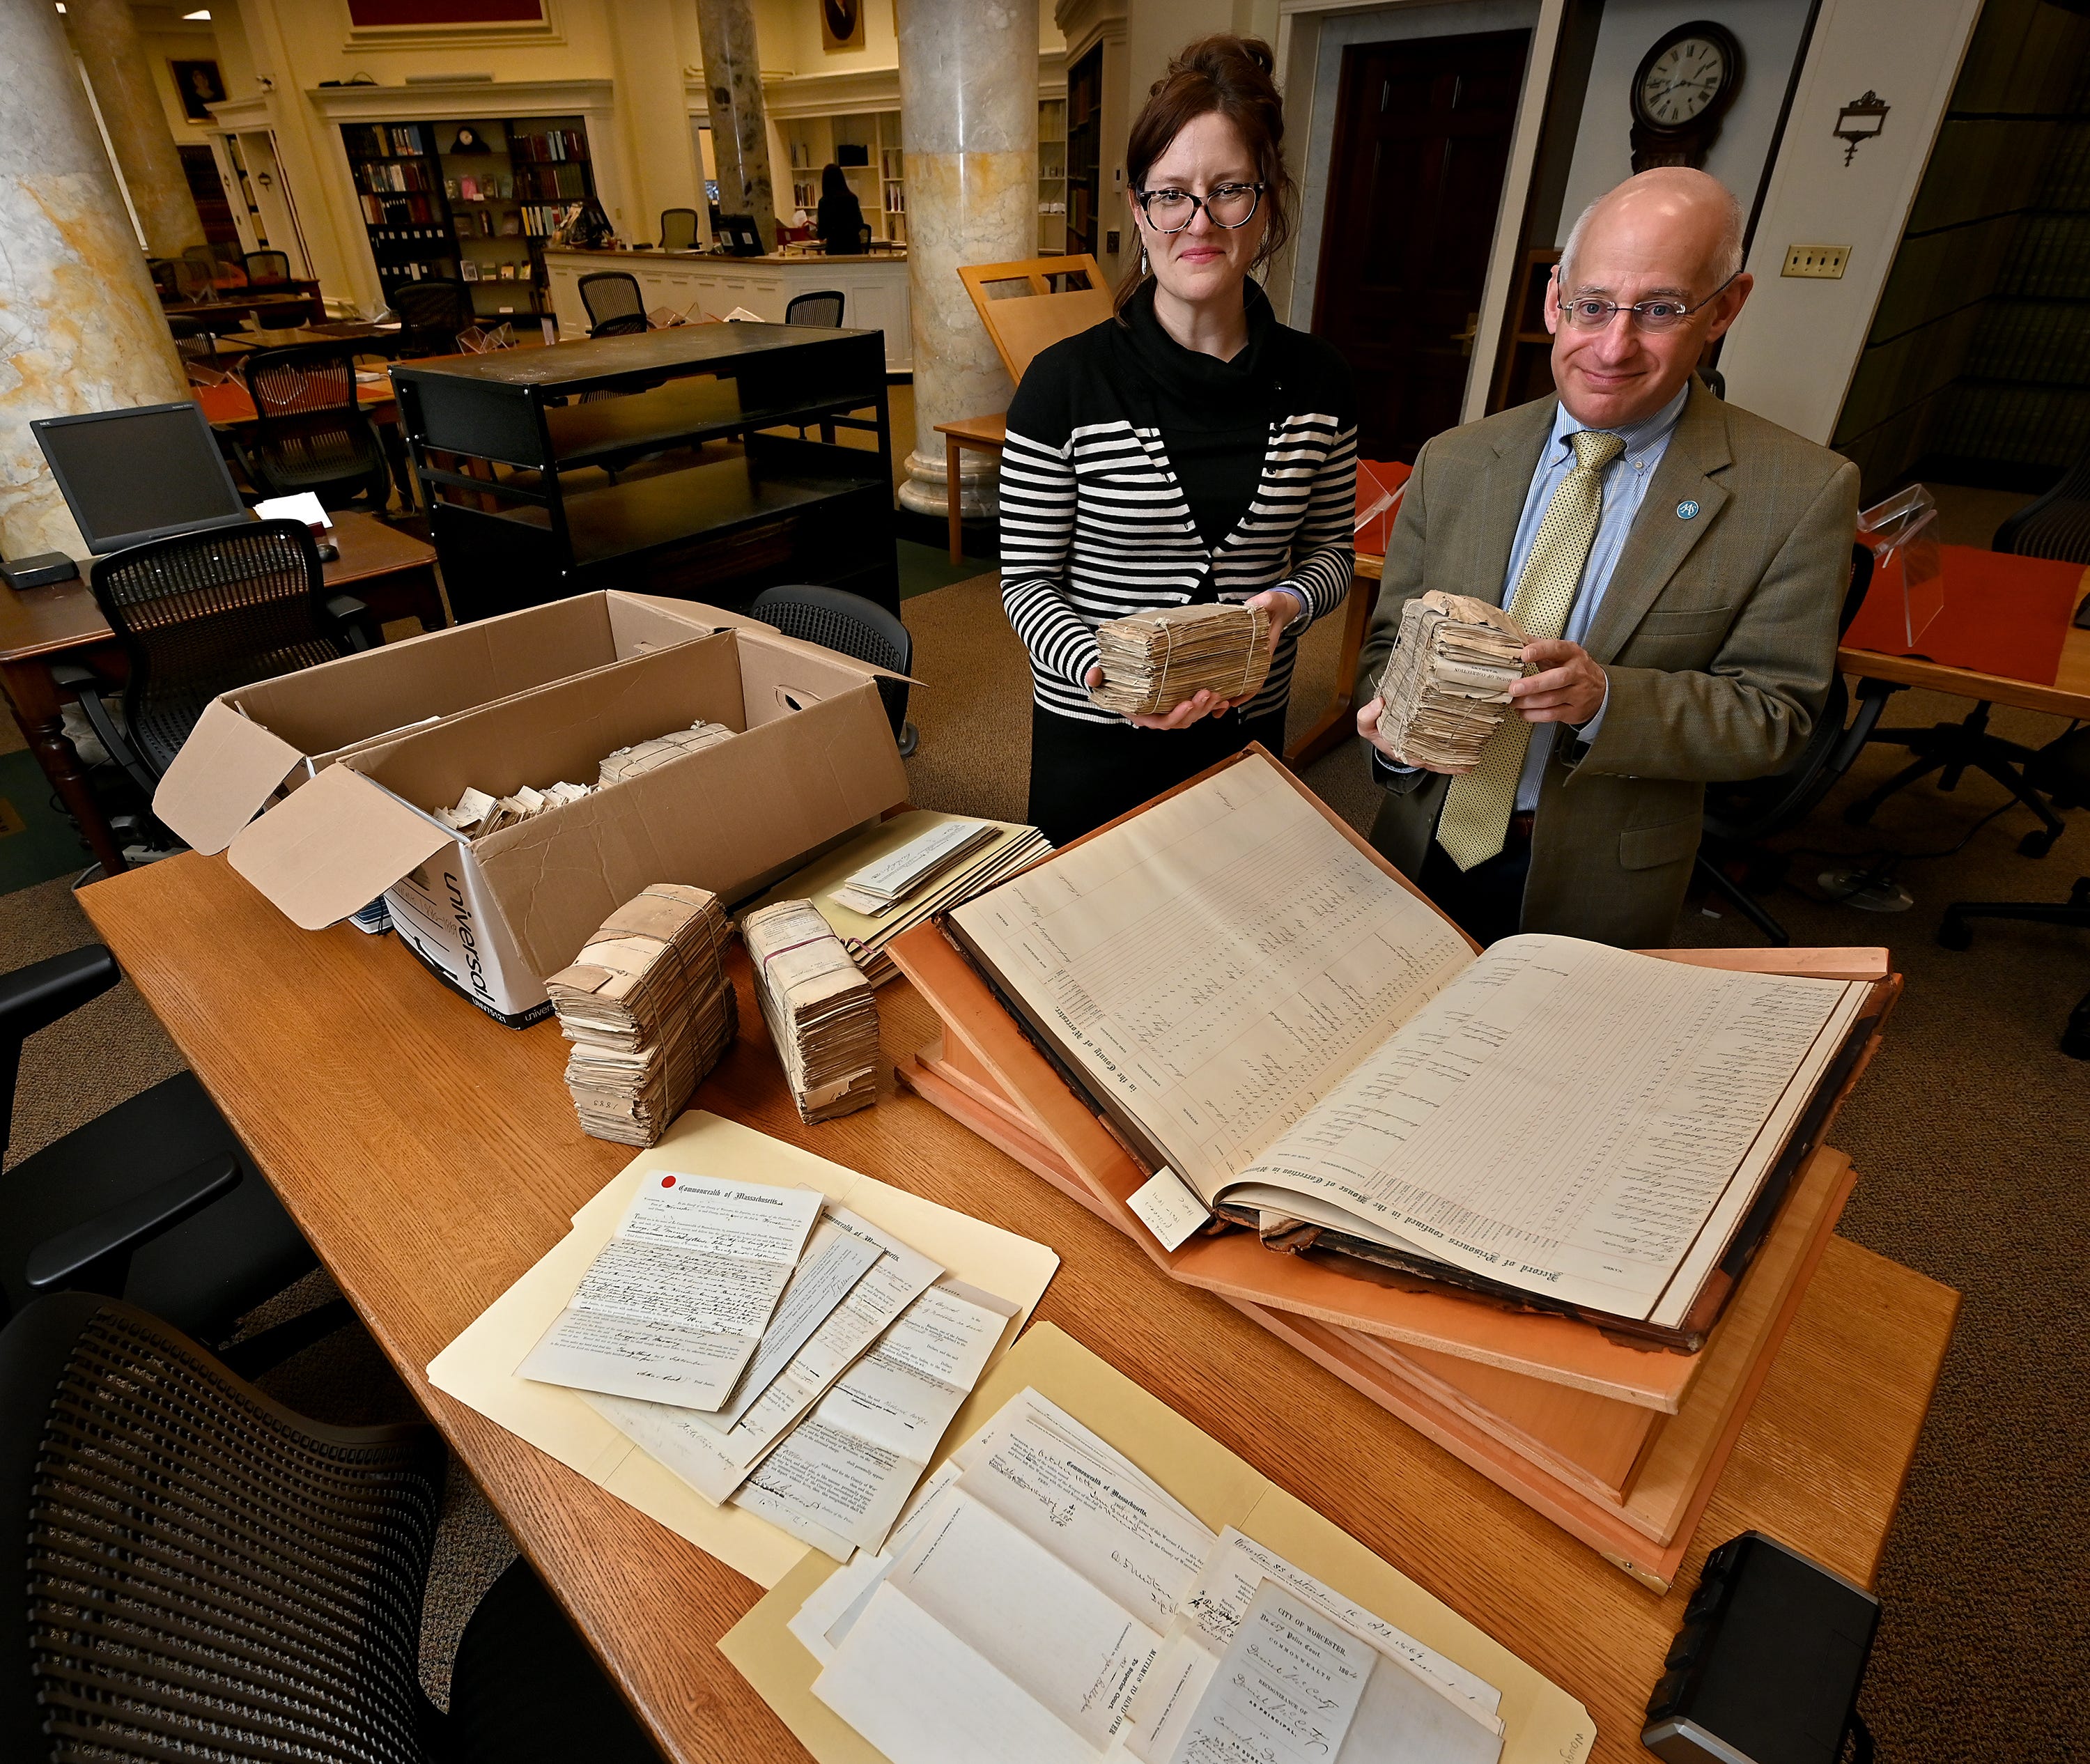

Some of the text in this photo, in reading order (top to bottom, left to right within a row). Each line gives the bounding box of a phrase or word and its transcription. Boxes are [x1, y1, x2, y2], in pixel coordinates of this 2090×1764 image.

[1453, 667, 1486, 677] CORRECTION
[444, 872, 495, 1003] universal
[472, 997, 506, 1023] UNV75121
[1052, 1005, 1138, 1093] in the County of Worcester.
[593, 1099, 618, 1110] 1883
[1271, 1166, 1281, 1175] in
[1281, 1167, 1324, 1184] Correction
[677, 1184, 722, 1196] Commonwealth
[1323, 1179, 1336, 1189] of
[1338, 1183, 1372, 1206] House
[1372, 1200, 1387, 1213] the
[1390, 1209, 1402, 1221] in
[820, 1209, 853, 1232] ommonwealth
[853, 1228, 864, 1239] of
[1402, 1214, 1443, 1239] confined
[1447, 1236, 1501, 1264] Prisoners
[1501, 1257, 1517, 1270] of
[1519, 1262, 1563, 1284] Record
[1065, 1459, 1104, 1487] Commonwealth
[1101, 1483, 1111, 1493] of
[1276, 1607, 1294, 1621] CITY
[1294, 1617, 1306, 1628] OF
[1285, 1630, 1303, 1646] Police
[1267, 1636, 1333, 1682] COMMONWEALTH
[1106, 1657, 1139, 1711] To Superior Court.
[1107, 1648, 1157, 1735] MITTIMUS TO BIND OVER
[1247, 1699, 1257, 1708] AS
[1257, 1678, 1309, 1716] RECOGNIZANCE OF
[1231, 1741, 1241, 1750] AS
